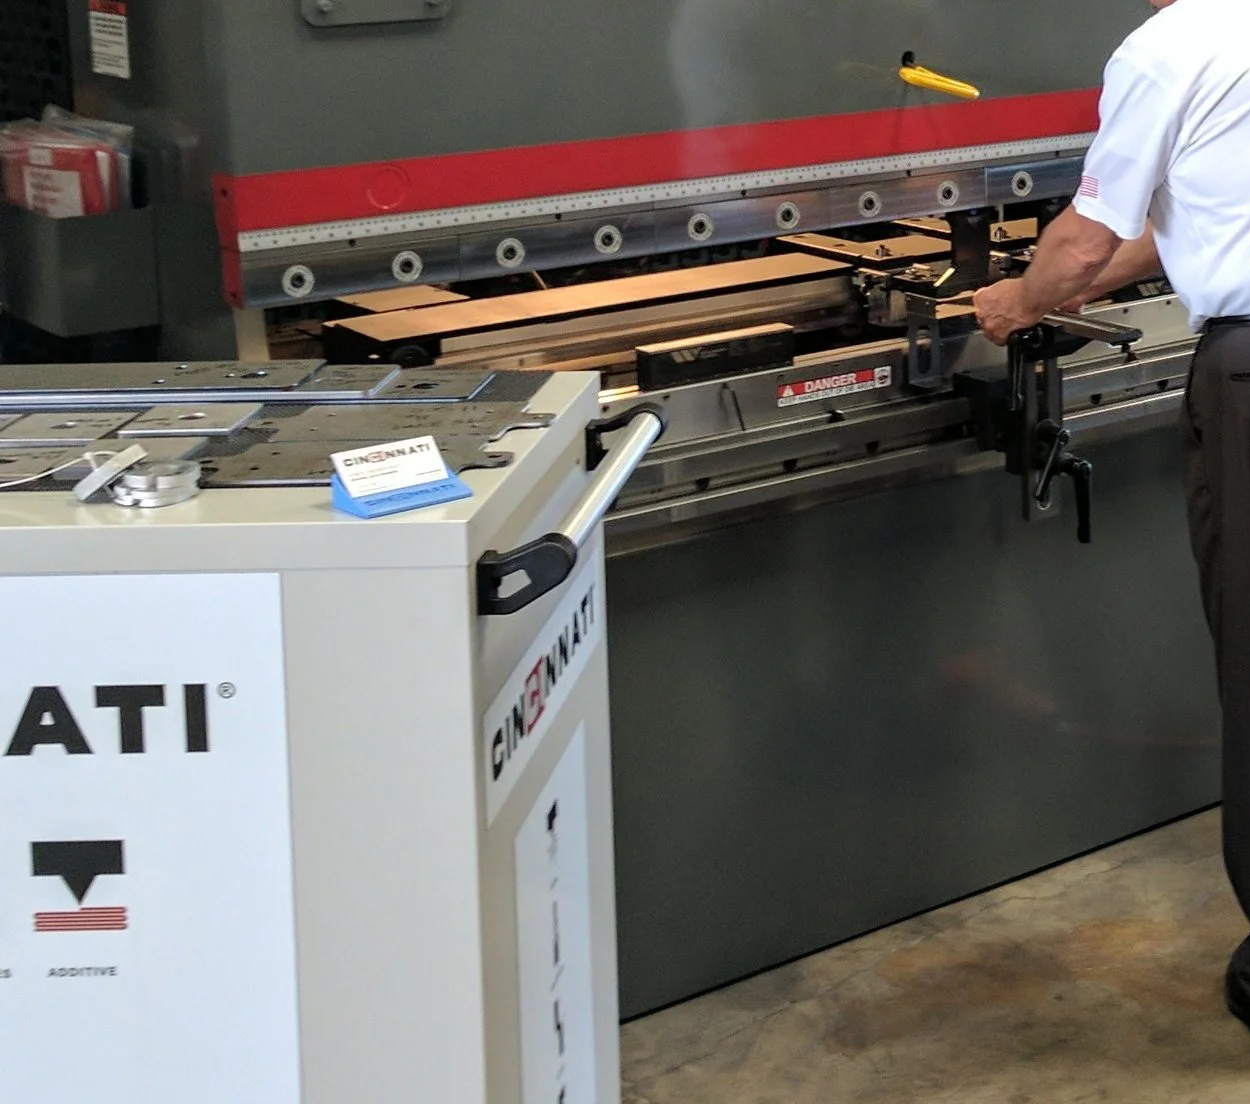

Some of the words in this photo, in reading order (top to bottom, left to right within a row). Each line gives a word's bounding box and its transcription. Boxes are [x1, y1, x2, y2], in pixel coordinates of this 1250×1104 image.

[804, 372, 857, 393] DANGER
[343, 443, 431, 467] CINCINNATI
[491, 582, 595, 782] CINCINNATI
[47, 966, 117, 978] ADDITIVE
